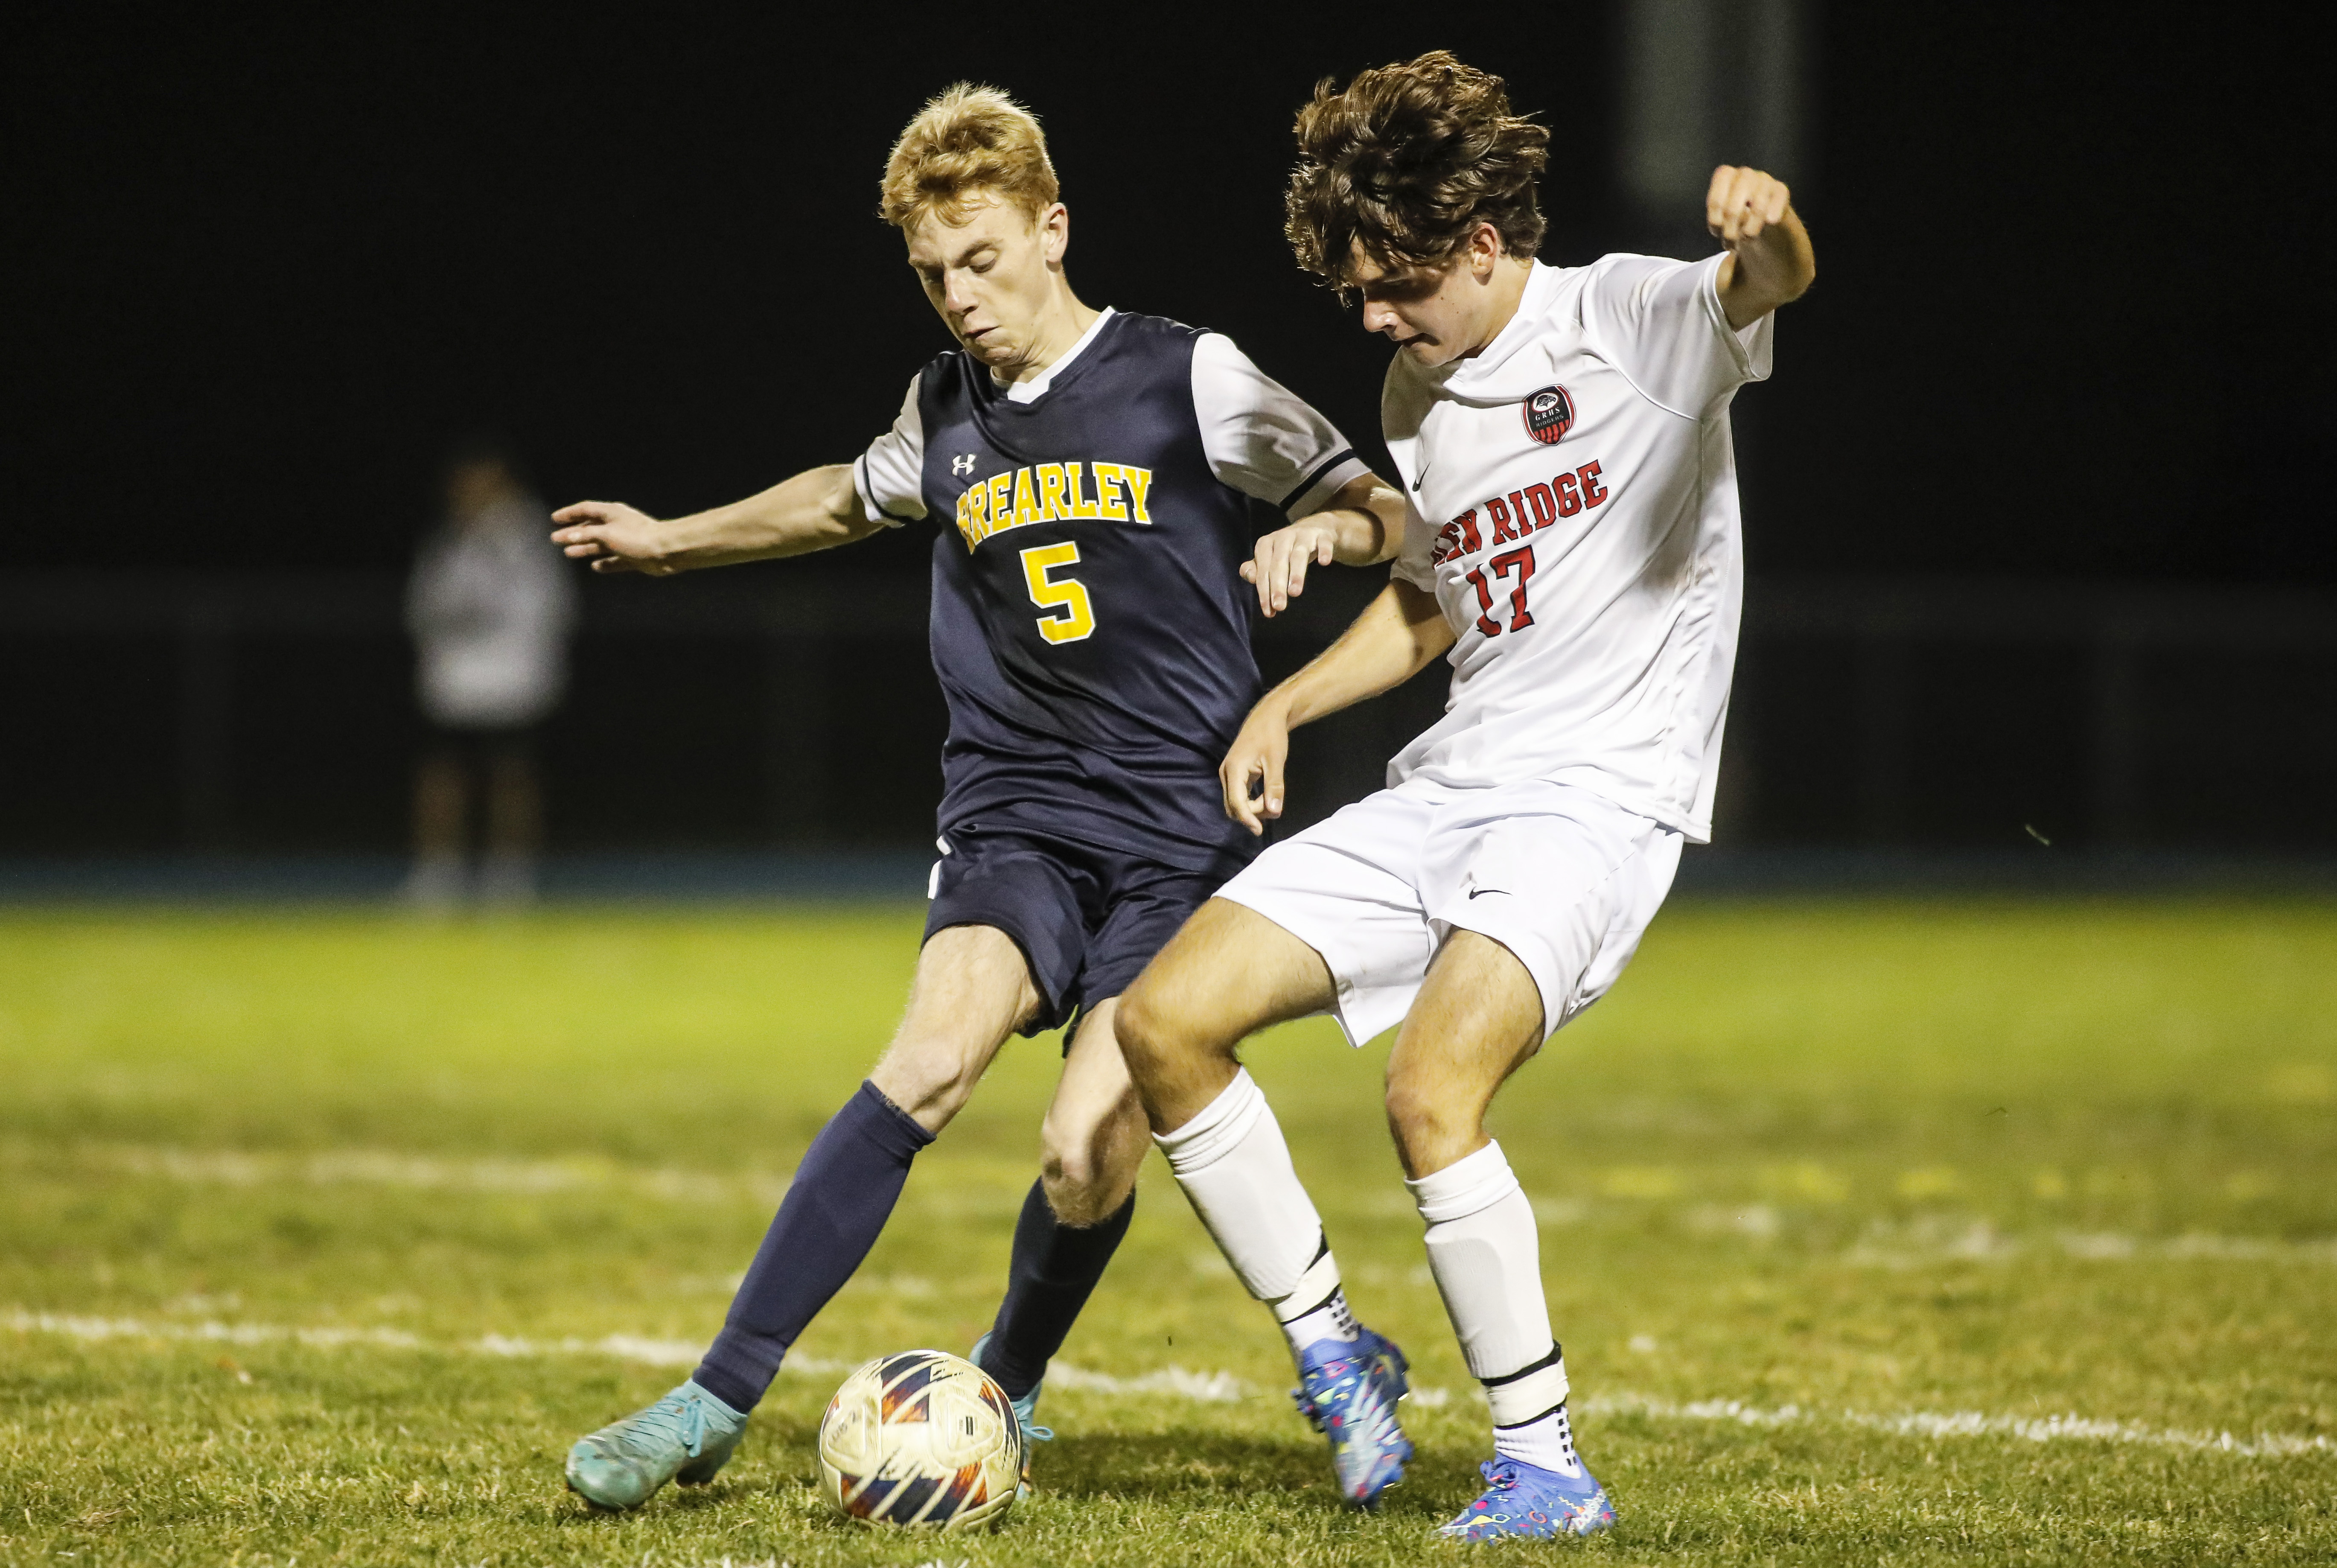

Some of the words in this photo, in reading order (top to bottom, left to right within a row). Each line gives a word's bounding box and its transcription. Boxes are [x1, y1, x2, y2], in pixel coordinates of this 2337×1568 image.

[1535, 407, 1560, 421] GRHS
[1536, 414, 1564, 427] RIDGERS
[1484, 459, 1608, 545] RIDGE
[1019, 541, 1096, 645] 5
[1466, 544, 1536, 638] 17
